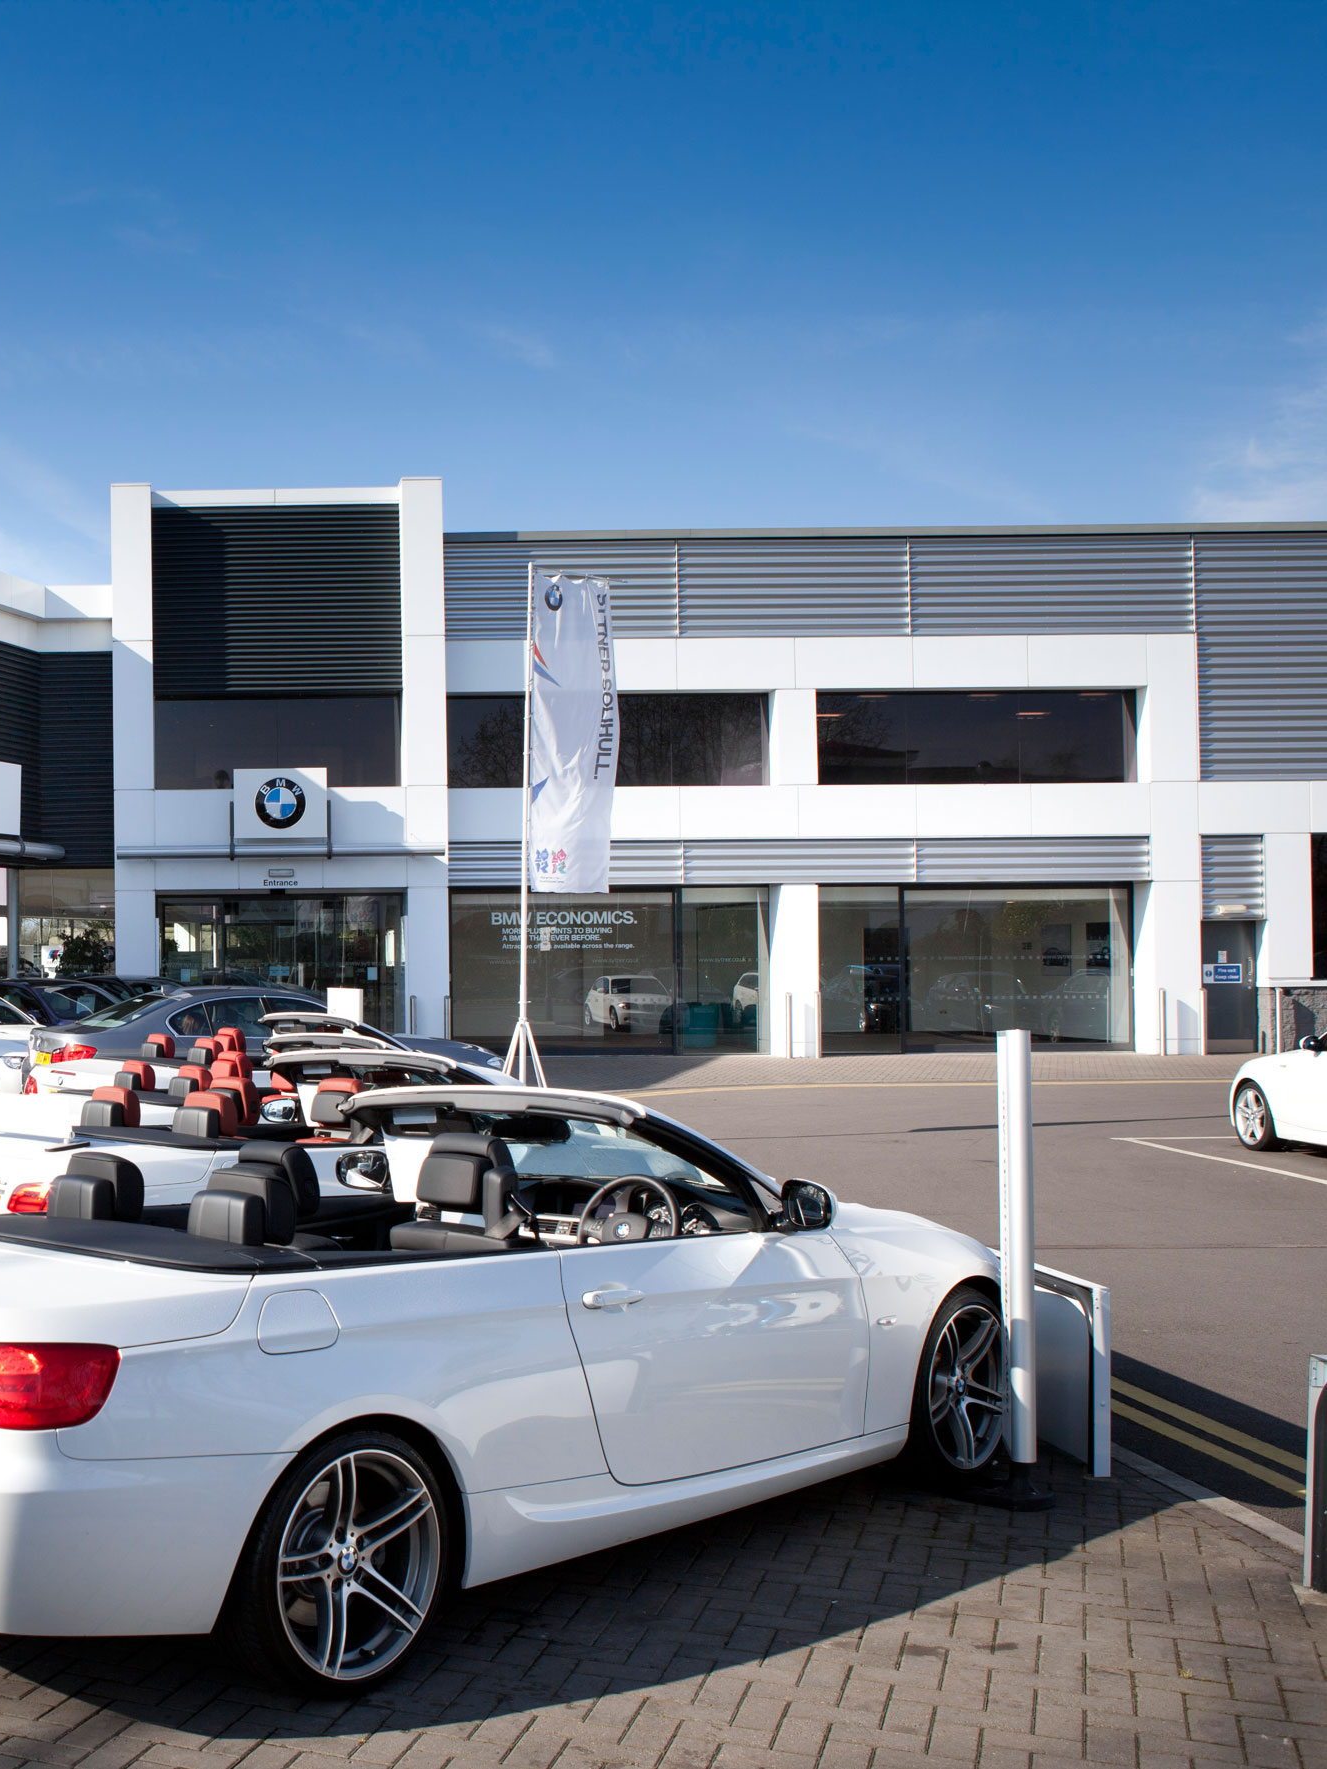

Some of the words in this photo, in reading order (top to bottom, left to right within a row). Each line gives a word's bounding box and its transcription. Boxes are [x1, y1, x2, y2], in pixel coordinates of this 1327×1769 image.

[260, 779, 303, 796] BMW
[263, 879, 298, 887] Entrance
[491, 912, 531, 926] BMW
[536, 910, 638, 926] ECONOMICS.
[501, 927, 522, 935] MORE
[547, 927, 573, 935] OINTS
